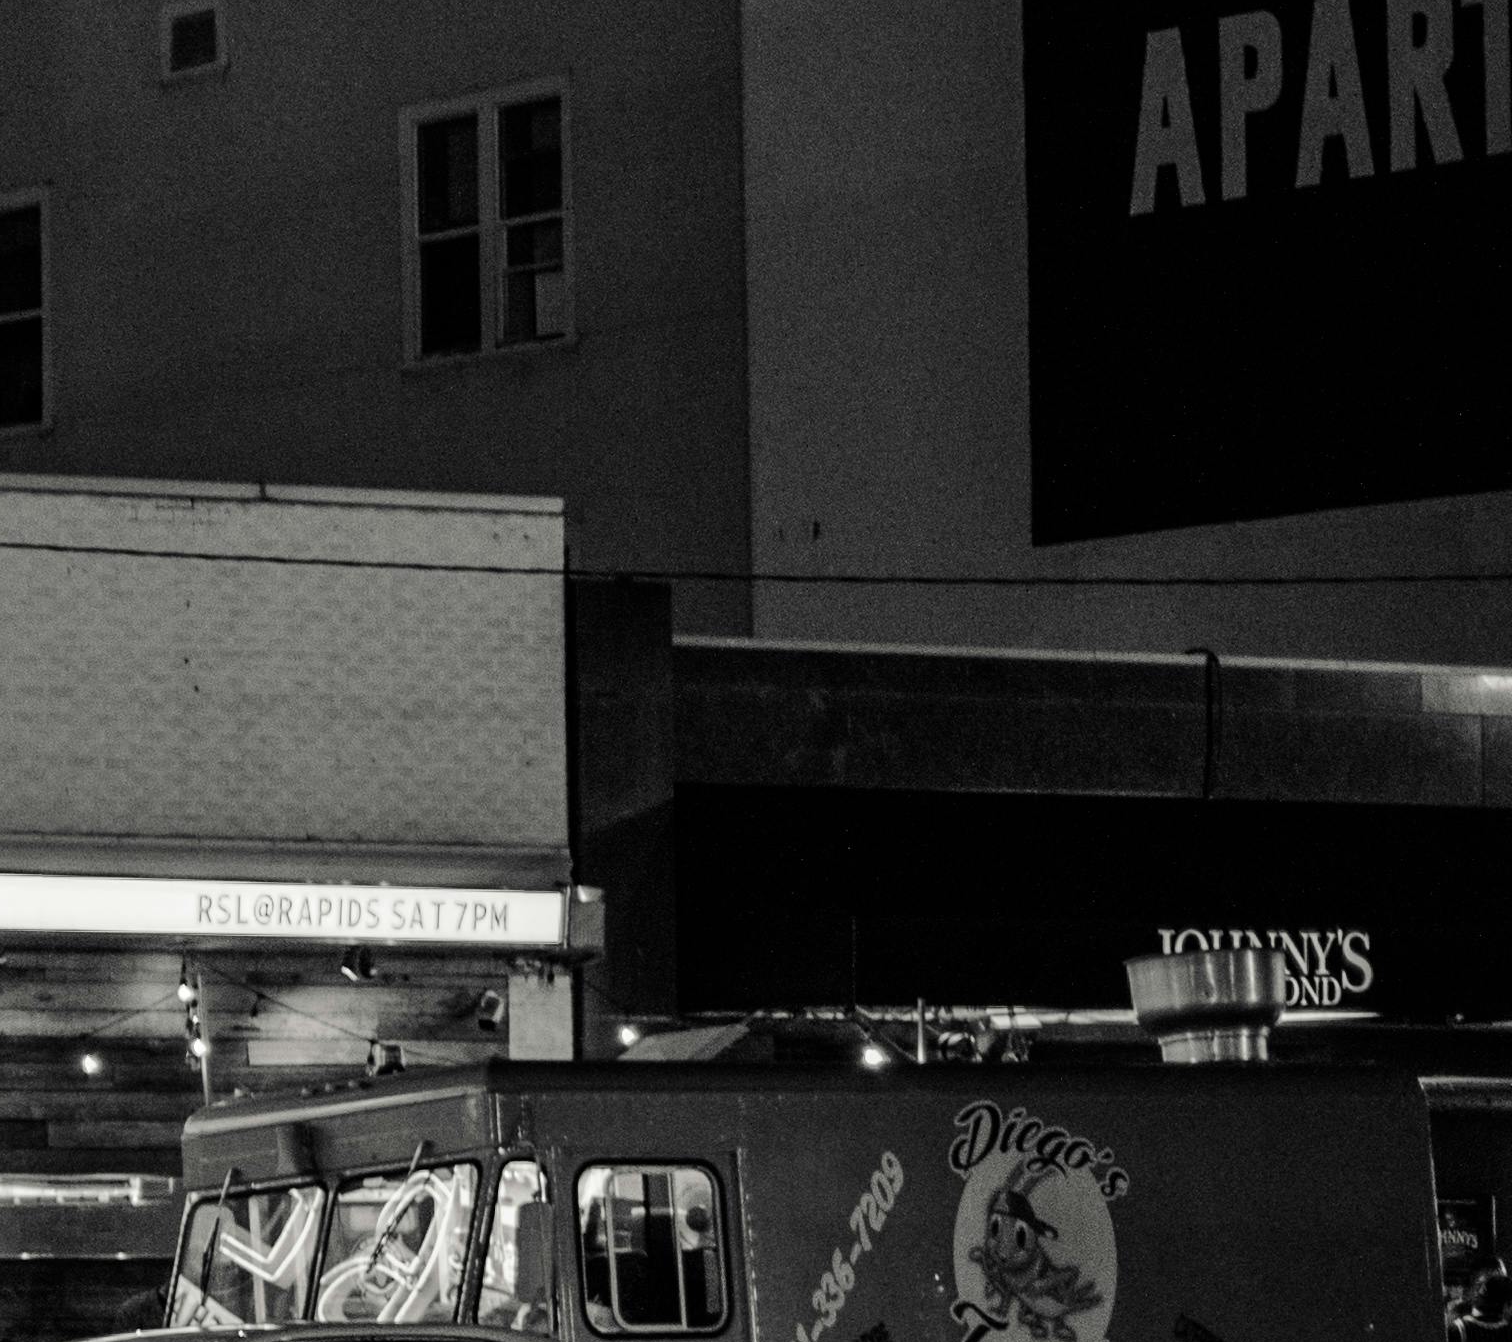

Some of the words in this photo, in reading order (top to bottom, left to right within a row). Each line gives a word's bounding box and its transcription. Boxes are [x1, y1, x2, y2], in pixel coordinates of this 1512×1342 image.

[198, 893, 382, 930] RSL@RAPIDS
[391, 897, 446, 932] SAT
[455, 900, 510, 933] 7PM
[949, 1100, 1131, 1201] Diego's
